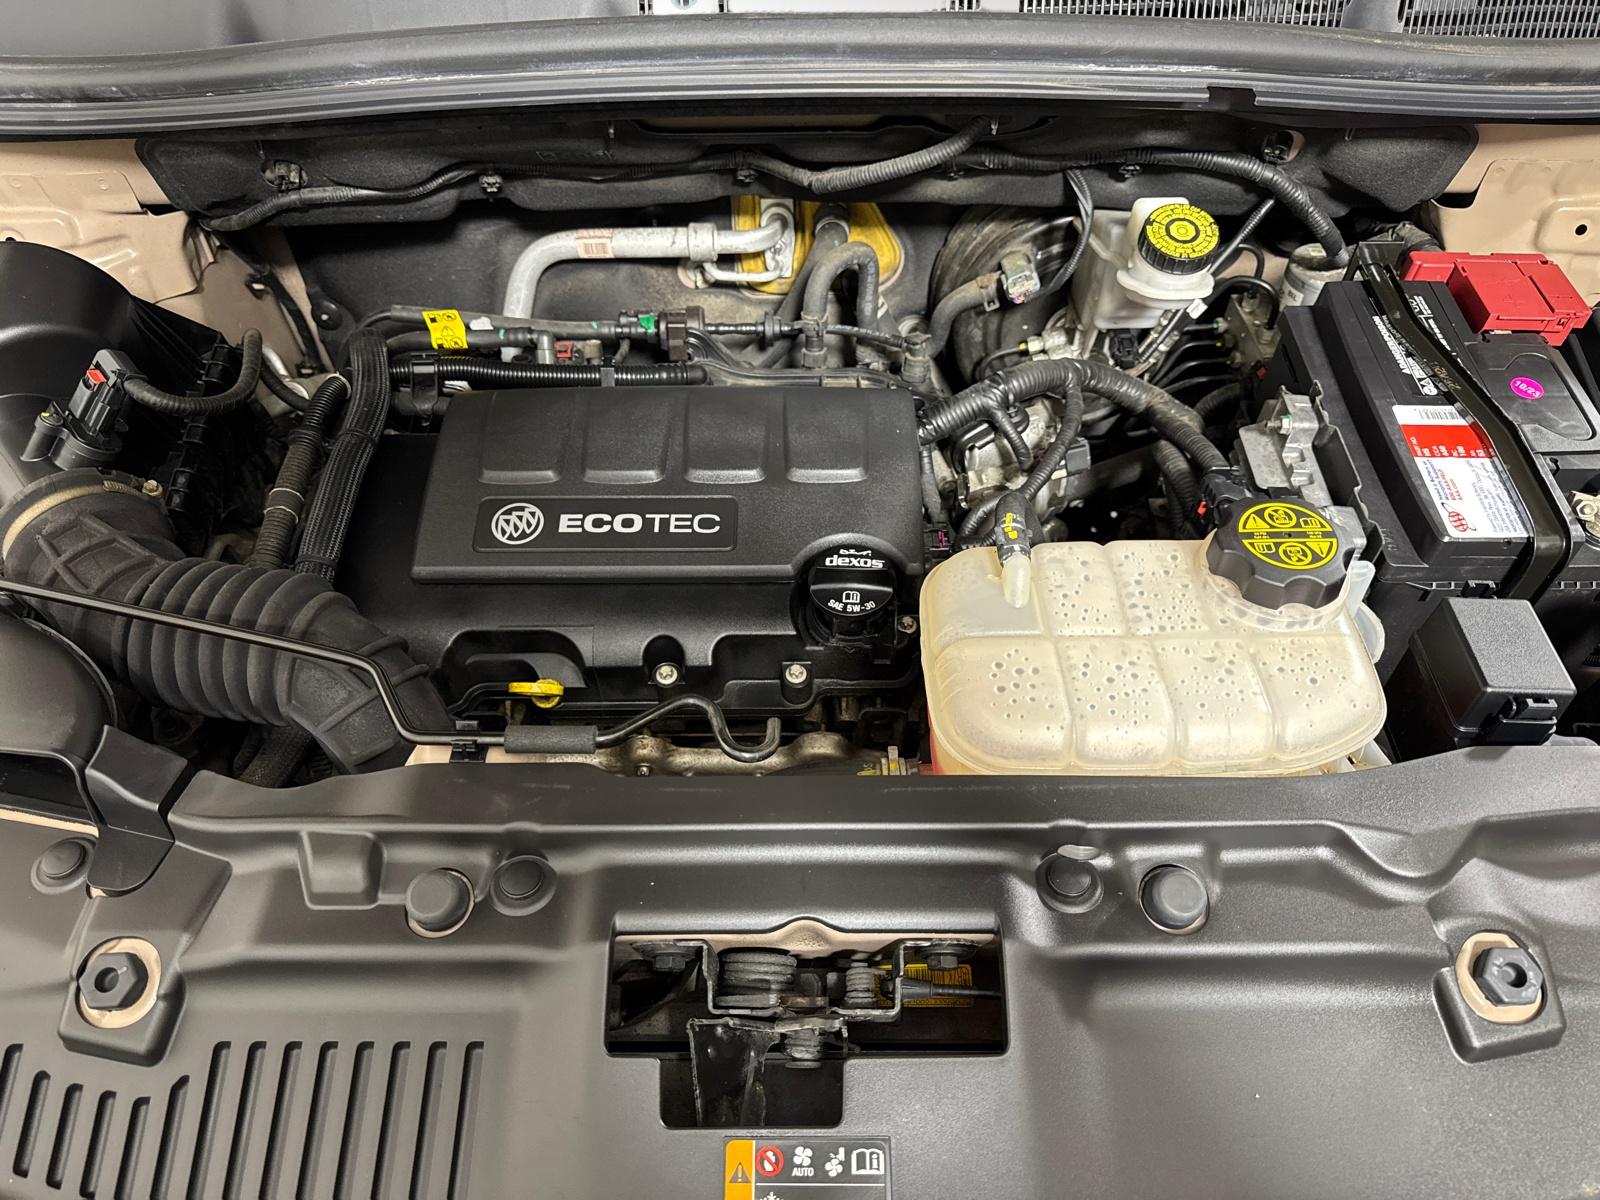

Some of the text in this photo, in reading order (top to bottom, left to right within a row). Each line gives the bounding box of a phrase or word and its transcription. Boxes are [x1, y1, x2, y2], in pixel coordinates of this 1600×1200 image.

[1515, 380, 1541, 398] 10/23
[1456, 445, 1467, 457] 100
[558, 513, 721, 534] ECOTEC
[825, 555, 886, 569] dexos
[827, 599, 876, 612] SAE 5W-30
[792, 1167, 815, 1177] AUTO
